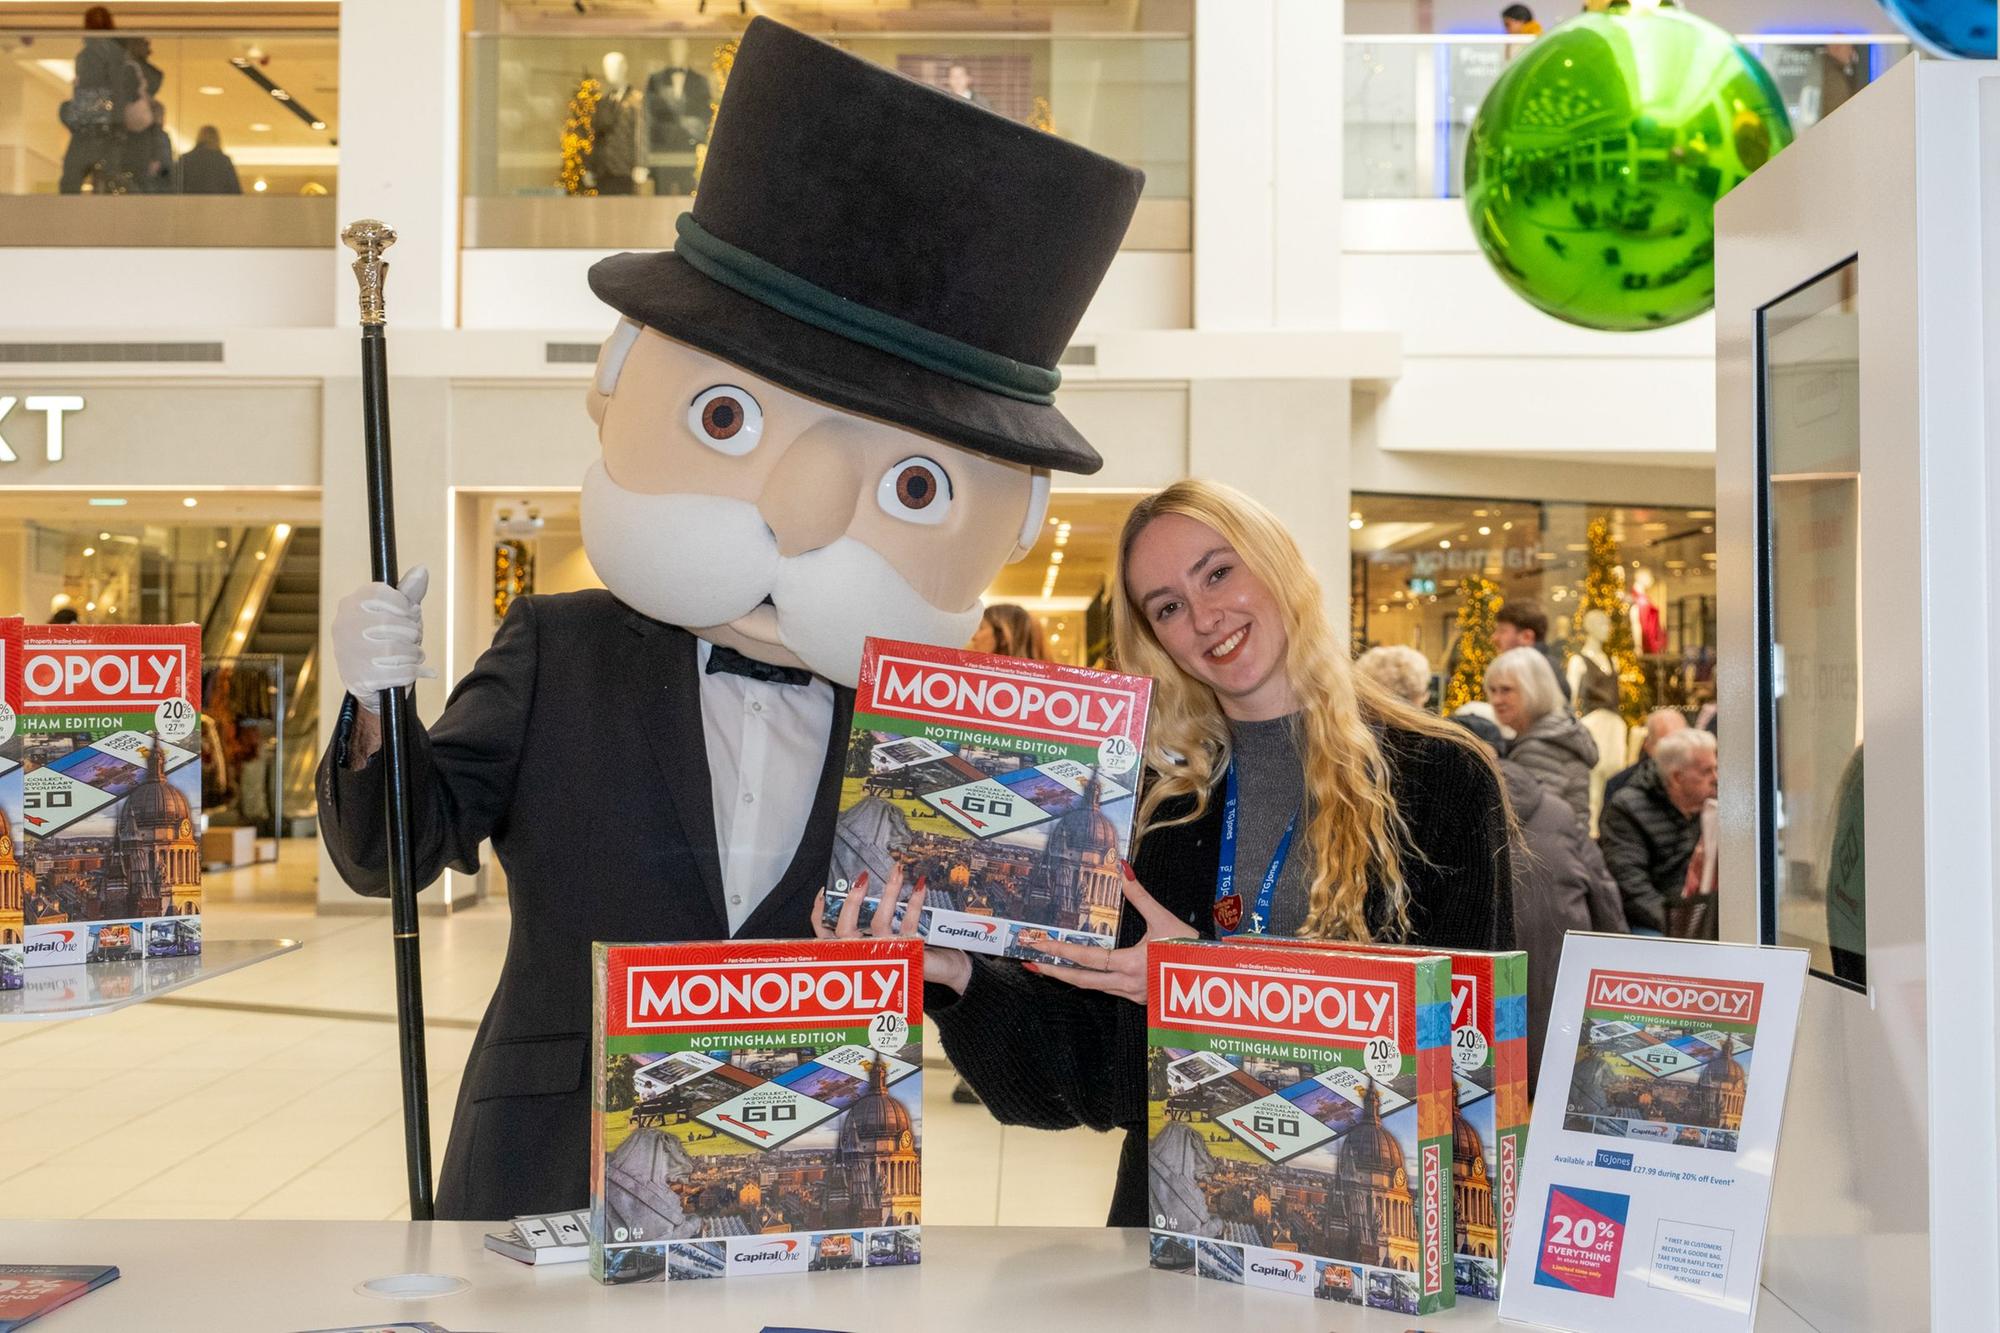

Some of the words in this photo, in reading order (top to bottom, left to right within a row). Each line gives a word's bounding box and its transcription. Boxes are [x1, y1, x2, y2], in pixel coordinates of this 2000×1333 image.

[884, 665, 1126, 732] MONOPOLY
[65, 716, 123, 730] EDITION
[925, 726, 1012, 748] NOTTINGHAM
[1015, 738, 1068, 756] EDITION
[962, 797, 1013, 818] GO
[1226, 807, 1236, 841] TGJones
[1261, 860, 1280, 894] TGJones
[638, 968, 900, 1017] MONOPOLY
[1169, 972, 1391, 1033] MONOPOLY
[1598, 981, 1748, 1014] MONOPOLY
[1624, 1014, 1677, 1026] NOTTINGHAM
[1680, 1020, 1713, 1029] EDITION
[690, 1034, 786, 1048] NOTTINGHAM
[790, 1031, 847, 1045] EDITION
[1210, 1038, 1289, 1058] NOTTINGHAM
[1293, 1047, 1343, 1063] EDITION
[1646, 1053, 1678, 1065] GO
[742, 1104, 797, 1123] GO
[1262, 1101, 1292, 1109] COLLECT
[1253, 1116, 1300, 1137] GO
[1554, 1155, 1585, 1166] Available
[1598, 1153, 1631, 1167] TGJones
[1633, 1166, 1657, 1176] £27.99
[1657, 1169, 1681, 1180] during
[1682, 1172, 1697, 1182] 20%
[1698, 1175, 1710, 1183] off
[1502, 1140, 1515, 1262] ONOPOLY
[563, 1223, 580, 1233] 2
[1425, 1151, 1440, 1288] MONOPOLY
[1550, 1214, 1615, 1248] 20%
[1547, 1246, 1612, 1263] EVERYTHING
[1595, 1240, 1614, 1251] off
[1662, 1246, 1682, 1254] RECEIVE
[1688, 1250, 1709, 1258] GOODIE
[1690, 1241, 1722, 1251] CUSTOMERS
[1663, 1264, 1680, 1272] STORE
[1680, 1266, 1688, 1274] TO
[1689, 1268, 1711, 1277] COLLECT
[1671, 1256, 1686, 1264] YOUR
[1687, 1258, 1706, 1267] RAFFLE
[1706, 1262, 1724, 1270] TICKET
[1674, 1275, 1701, 1284] PURCHASE
